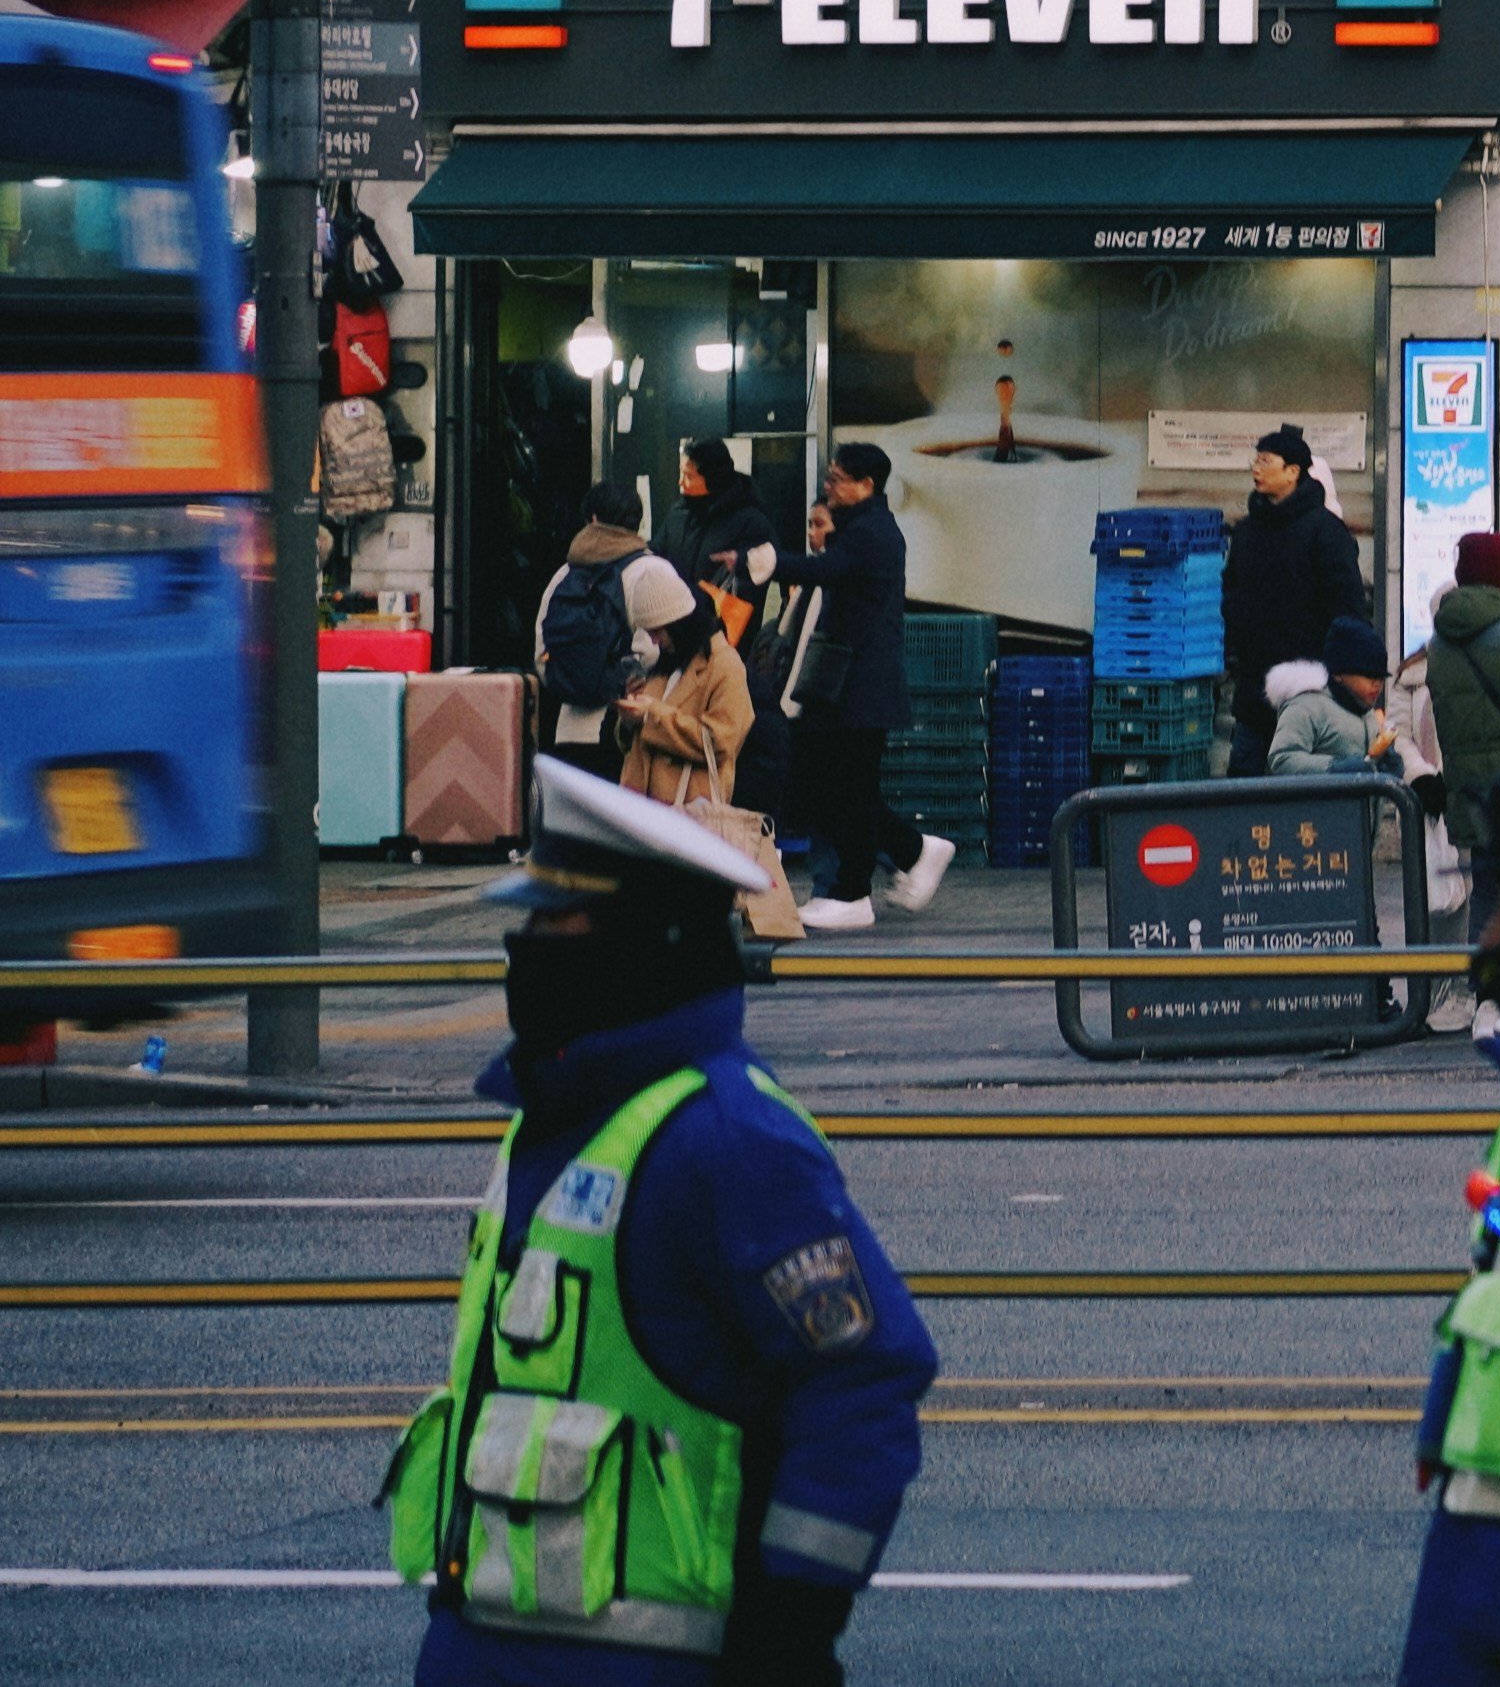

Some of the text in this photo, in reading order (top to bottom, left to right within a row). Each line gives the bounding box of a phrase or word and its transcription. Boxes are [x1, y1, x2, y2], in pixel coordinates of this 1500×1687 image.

[1094, 222, 1350, 249] SINCE 1927 세계 1등 편의점
[349, 341, 387, 387] Supreme
[1129, 920, 1177, 950] 걷자,
[1261, 930, 1354, 950] 10:00~23:00
[1143, 1001, 1196, 1018] 서울특별시
